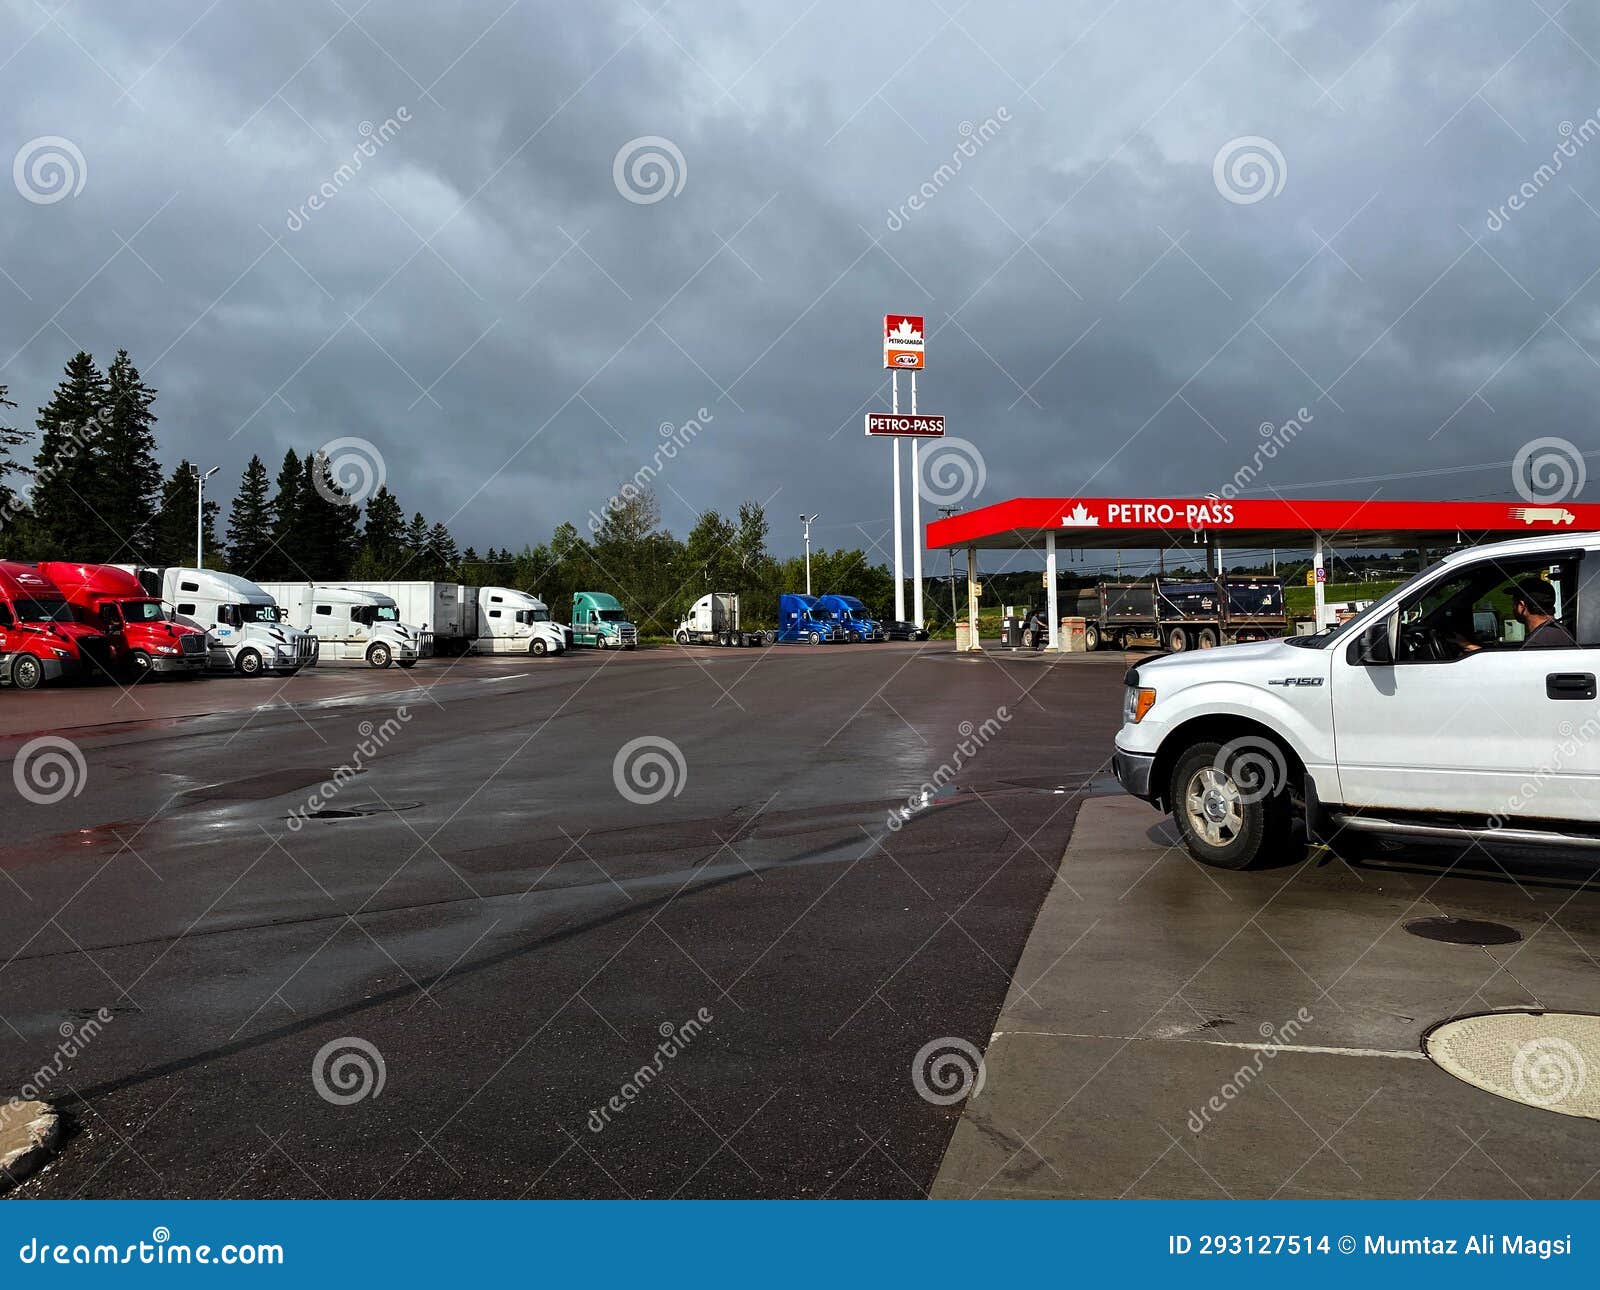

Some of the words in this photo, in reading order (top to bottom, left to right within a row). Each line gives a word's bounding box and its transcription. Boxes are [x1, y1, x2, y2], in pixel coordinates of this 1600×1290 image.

[888, 338, 923, 346] PETRO-CANADA
[896, 356, 917, 364] A&W
[870, 417, 944, 432] PETRO-PASS
[1107, 503, 1235, 524] PETRO-PASS
